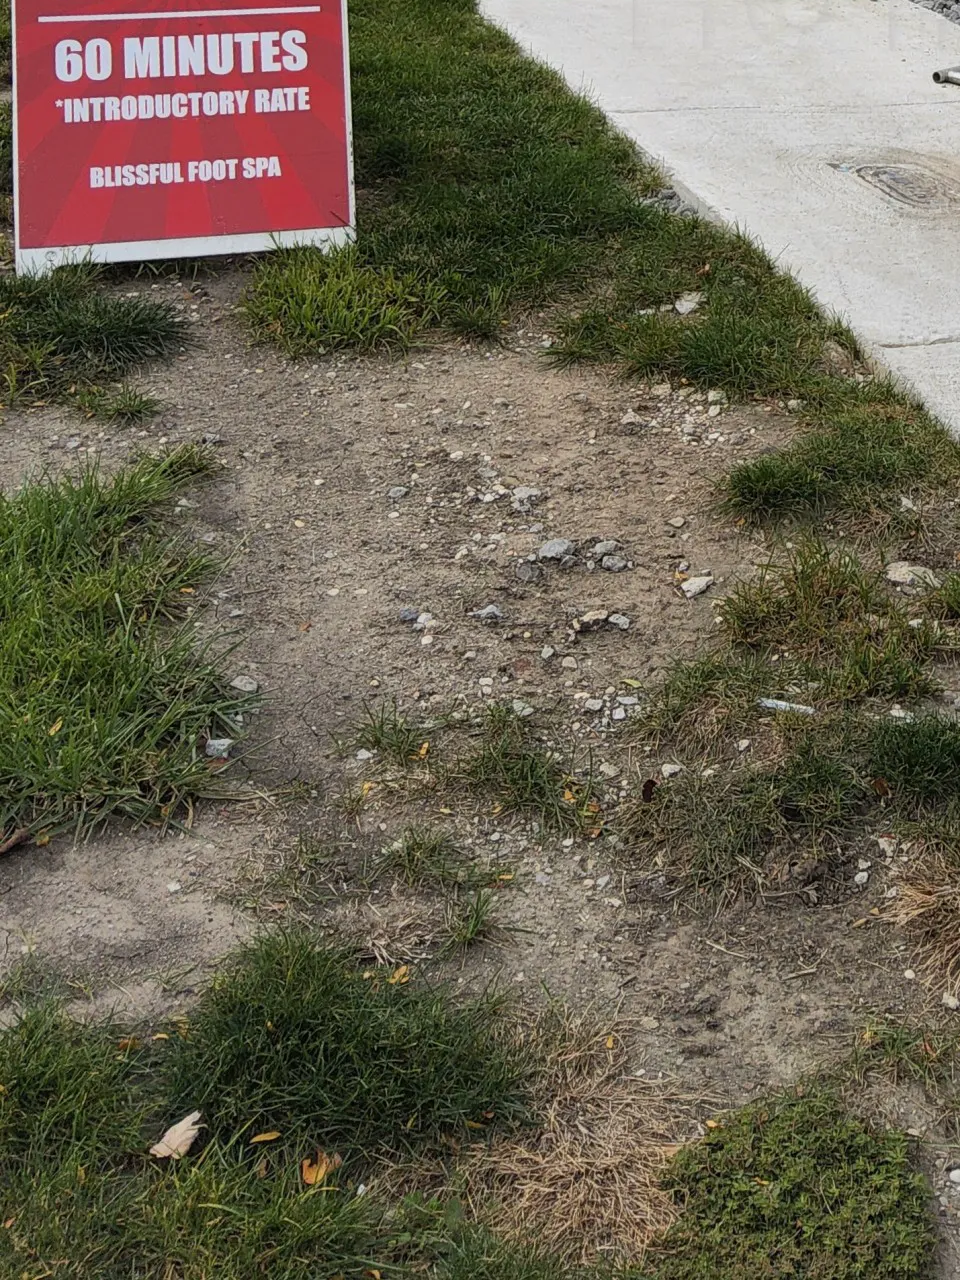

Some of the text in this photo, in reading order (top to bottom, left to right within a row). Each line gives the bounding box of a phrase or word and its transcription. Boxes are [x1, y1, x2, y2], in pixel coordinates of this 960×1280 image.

[54, 29, 308, 83] 60 MINUTES
[254, 86, 310, 113] RATE
[89, 156, 282, 189] BLISSFUL FOOT SPA
